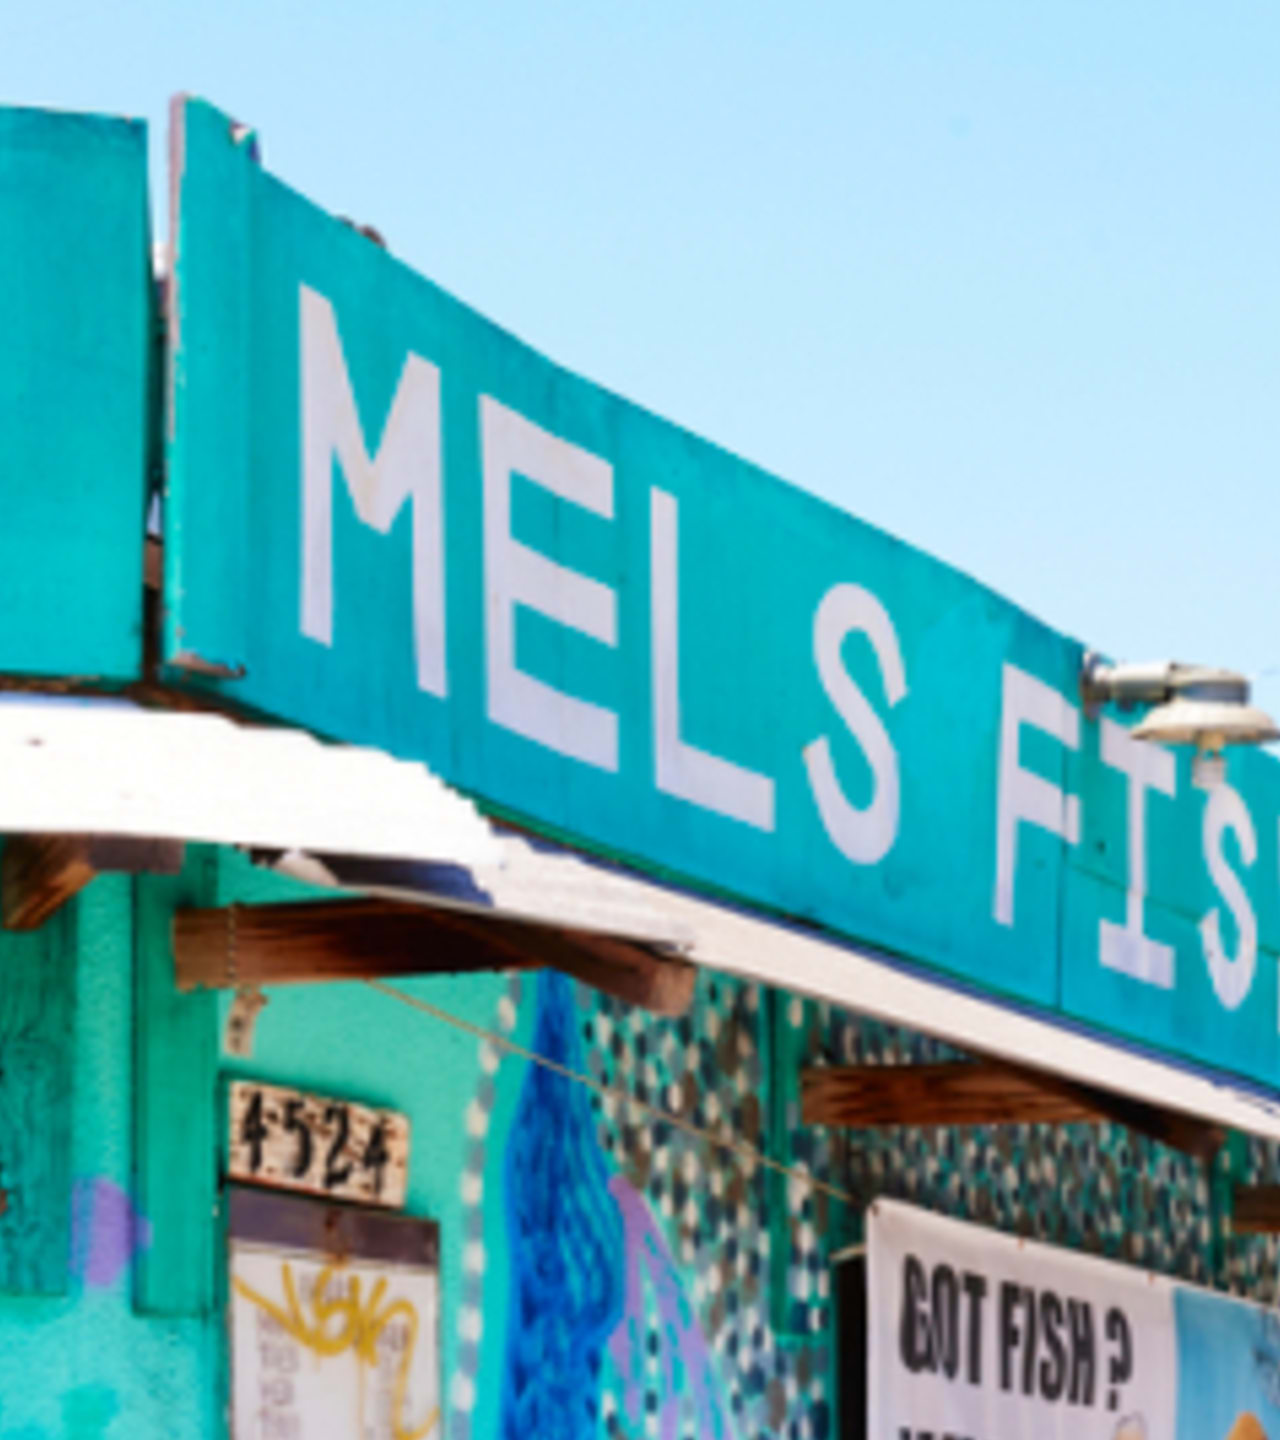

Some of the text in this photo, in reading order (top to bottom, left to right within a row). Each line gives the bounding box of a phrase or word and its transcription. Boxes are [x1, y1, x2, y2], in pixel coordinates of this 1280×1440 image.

[299, 281, 909, 865] MELS
[240, 1088, 391, 1197] 4524
[898, 1252, 987, 1386] GOT
[999, 1280, 1096, 1408] FISH
